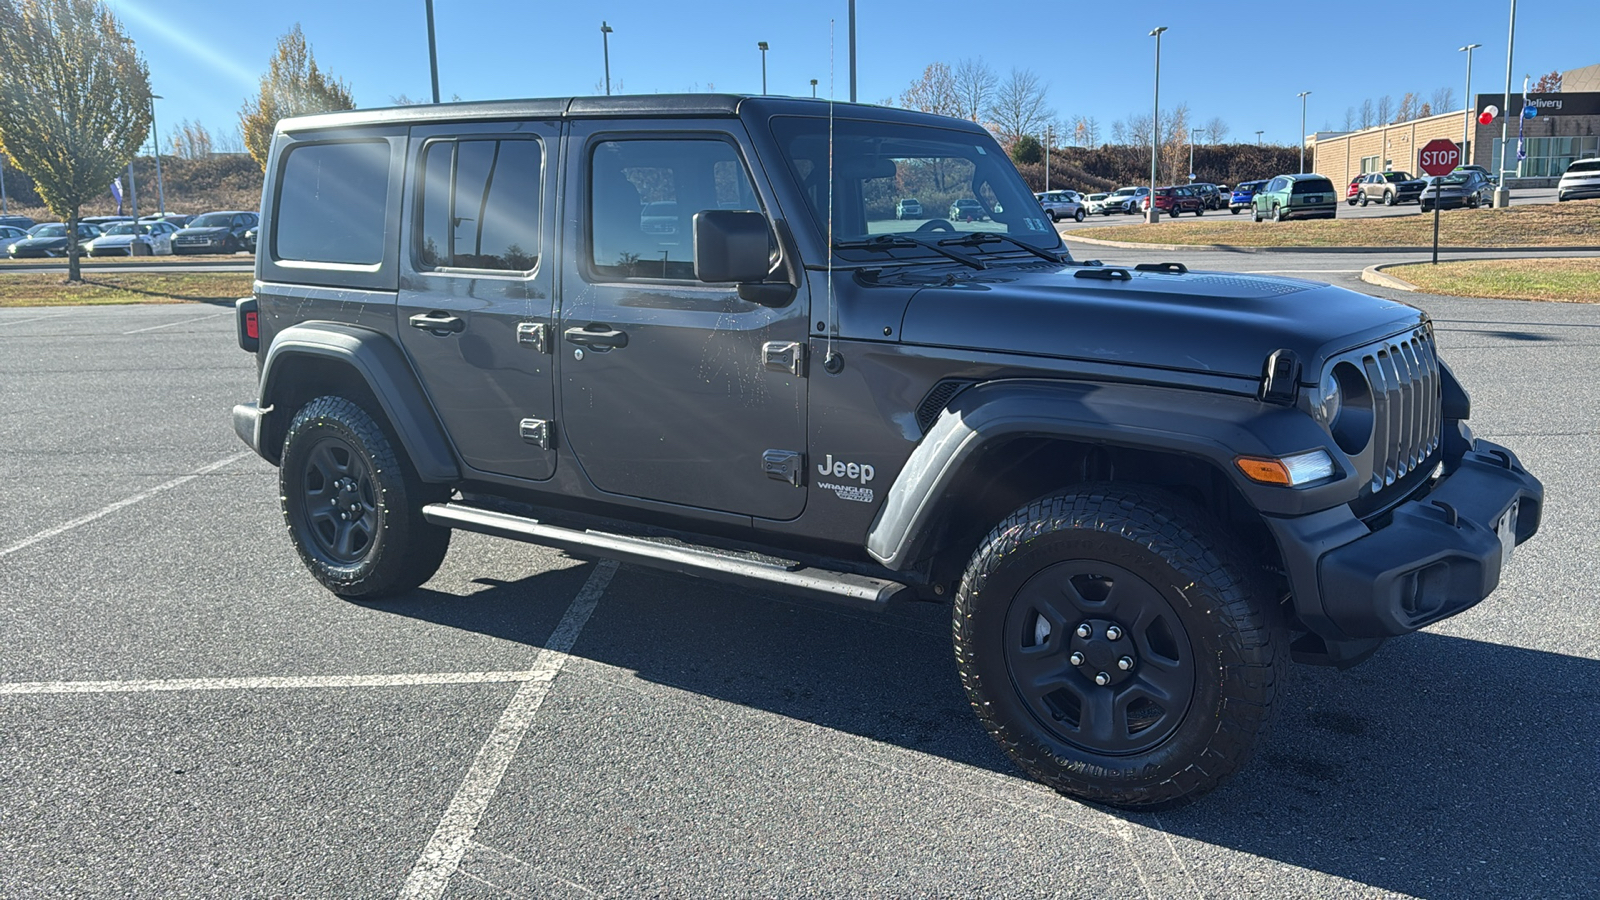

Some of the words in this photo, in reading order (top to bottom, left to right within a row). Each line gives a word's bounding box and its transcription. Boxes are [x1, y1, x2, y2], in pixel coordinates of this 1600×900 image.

[1526, 98, 1563, 110] Delivery
[1422, 150, 1458, 167] STOP
[817, 454, 875, 485] Jeep
[817, 481, 873, 494] WRANGLER
